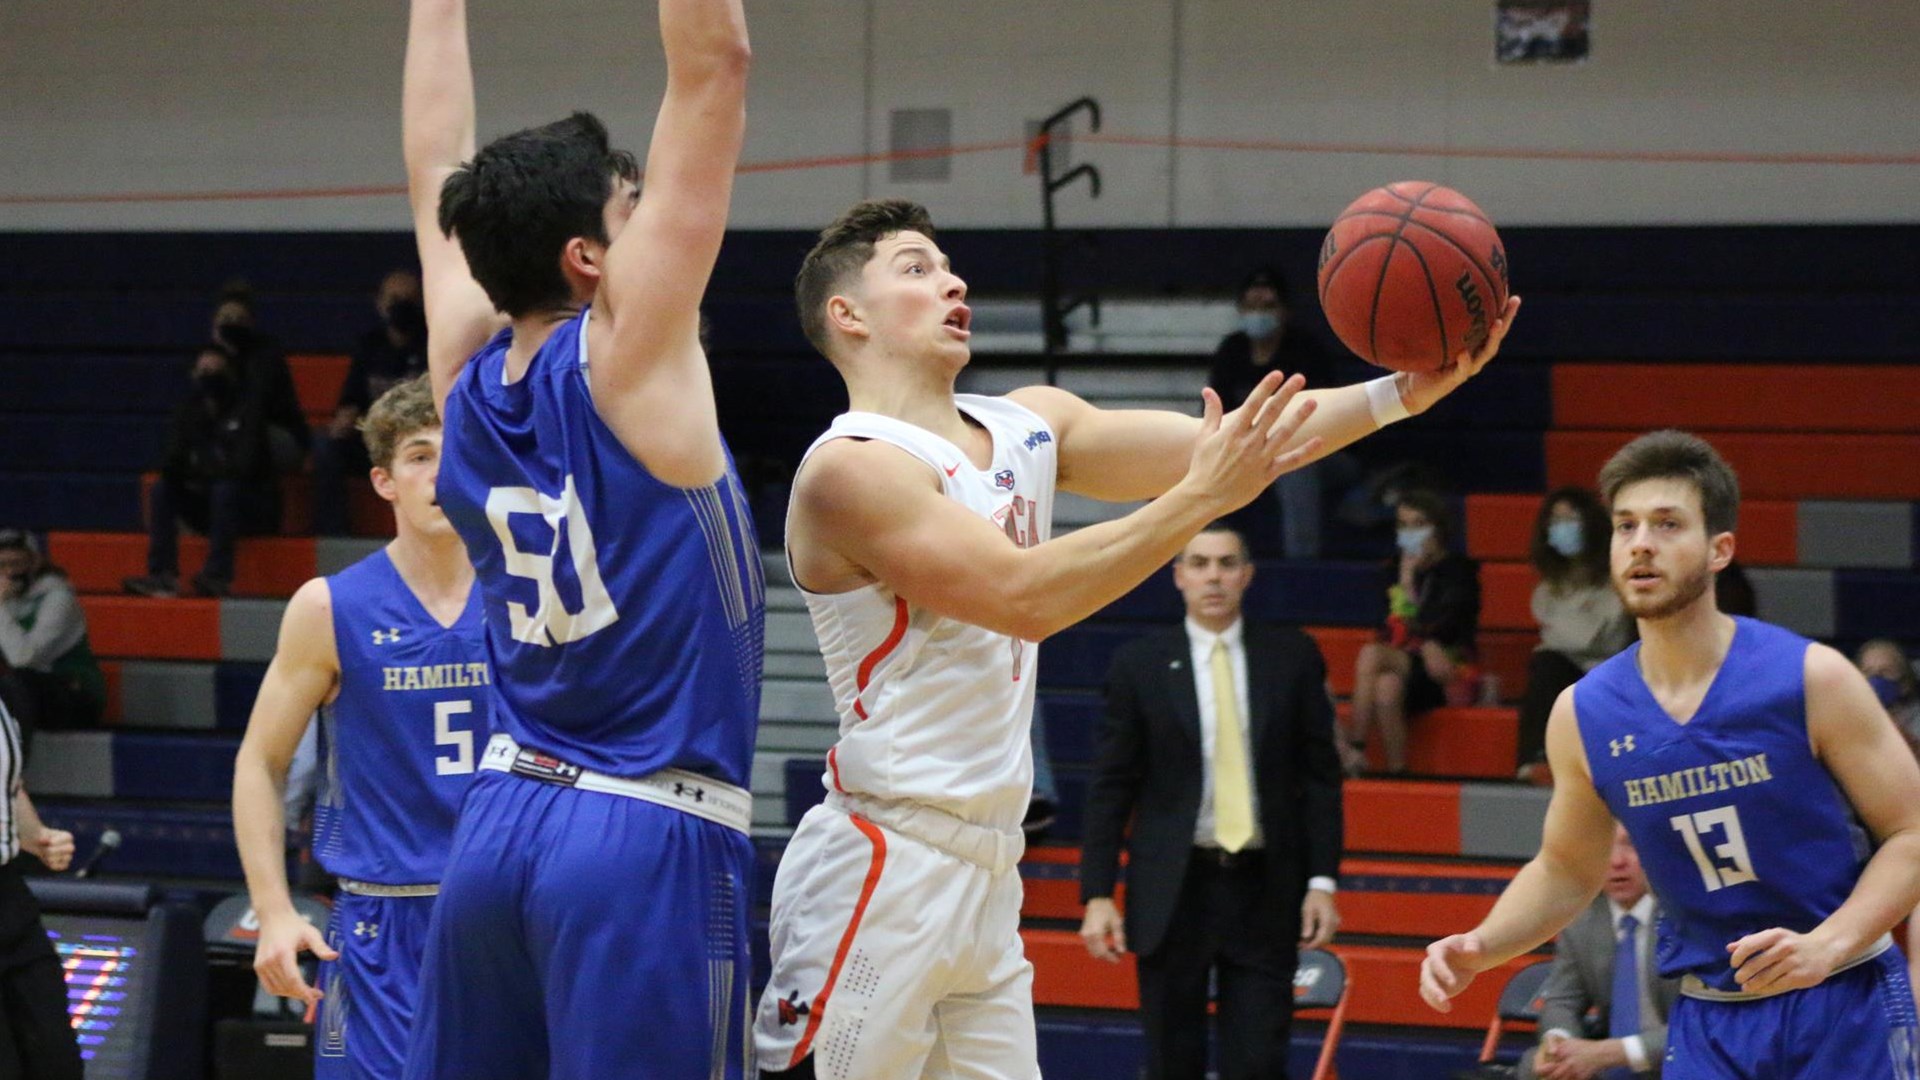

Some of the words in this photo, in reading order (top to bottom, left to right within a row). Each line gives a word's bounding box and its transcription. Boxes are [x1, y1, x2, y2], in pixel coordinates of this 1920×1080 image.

[485, 474, 619, 647] 50
[383, 662, 491, 691] HAMILT
[434, 700, 475, 776] 5
[1624, 752, 1774, 807] HAMILTON
[1669, 804, 1760, 893] 13
